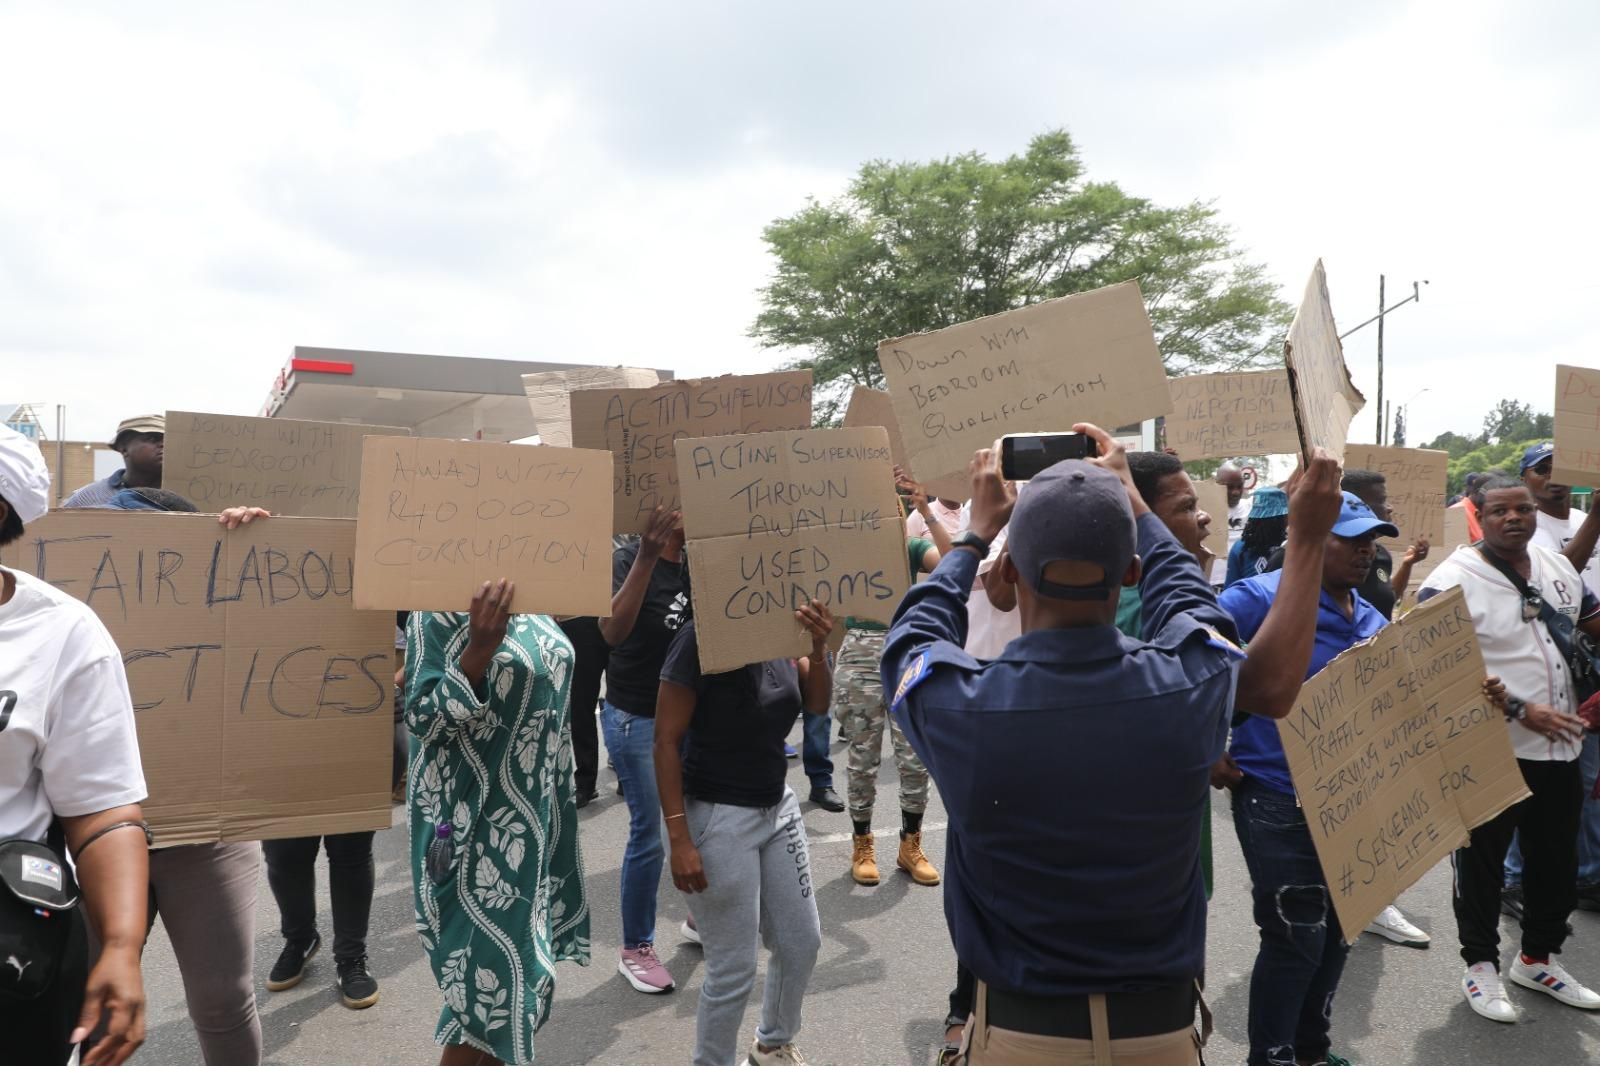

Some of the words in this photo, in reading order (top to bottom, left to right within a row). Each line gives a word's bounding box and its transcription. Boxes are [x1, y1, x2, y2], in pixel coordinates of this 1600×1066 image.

[908, 360, 1020, 409] BEDROOM
[1187, 398, 1275, 421] NEPOTISM
[279, 427, 336, 450] WITH
[1176, 423, 1237, 444] UNFAIR
[393, 451, 481, 488] AWAY
[496, 457, 583, 488] WITH
[693, 441, 777, 480] ACTING
[792, 437, 889, 464] SUPERVISORS
[188, 475, 360, 504] QUALIFICATI
[729, 476, 848, 513] THROWN
[747, 507, 828, 539] AWAY
[839, 508, 881, 530] LIKE
[374, 534, 591, 572] CORRUPTION
[741, 546, 830, 585] USED
[33, 535, 187, 621] FAIR
[205, 539, 353, 614] LABOU
[725, 570, 894, 620] CONDOMS
[1287, 672, 1345, 741] WHAT
[1354, 645, 1399, 697] ABOUT
[1402, 605, 1472, 653] FORMER
[1306, 711, 1364, 771] TRAFFIC
[1371, 690, 1393, 722] AND
[1313, 742, 1379, 809] SERVING
[1383, 702, 1439, 750] WITHOUT
[1319, 767, 1385, 839] PROMOTION
[1389, 730, 1438, 778] SINCE
[1439, 764, 1479, 802] FOR
[1392, 822, 1440, 871] LIFE
